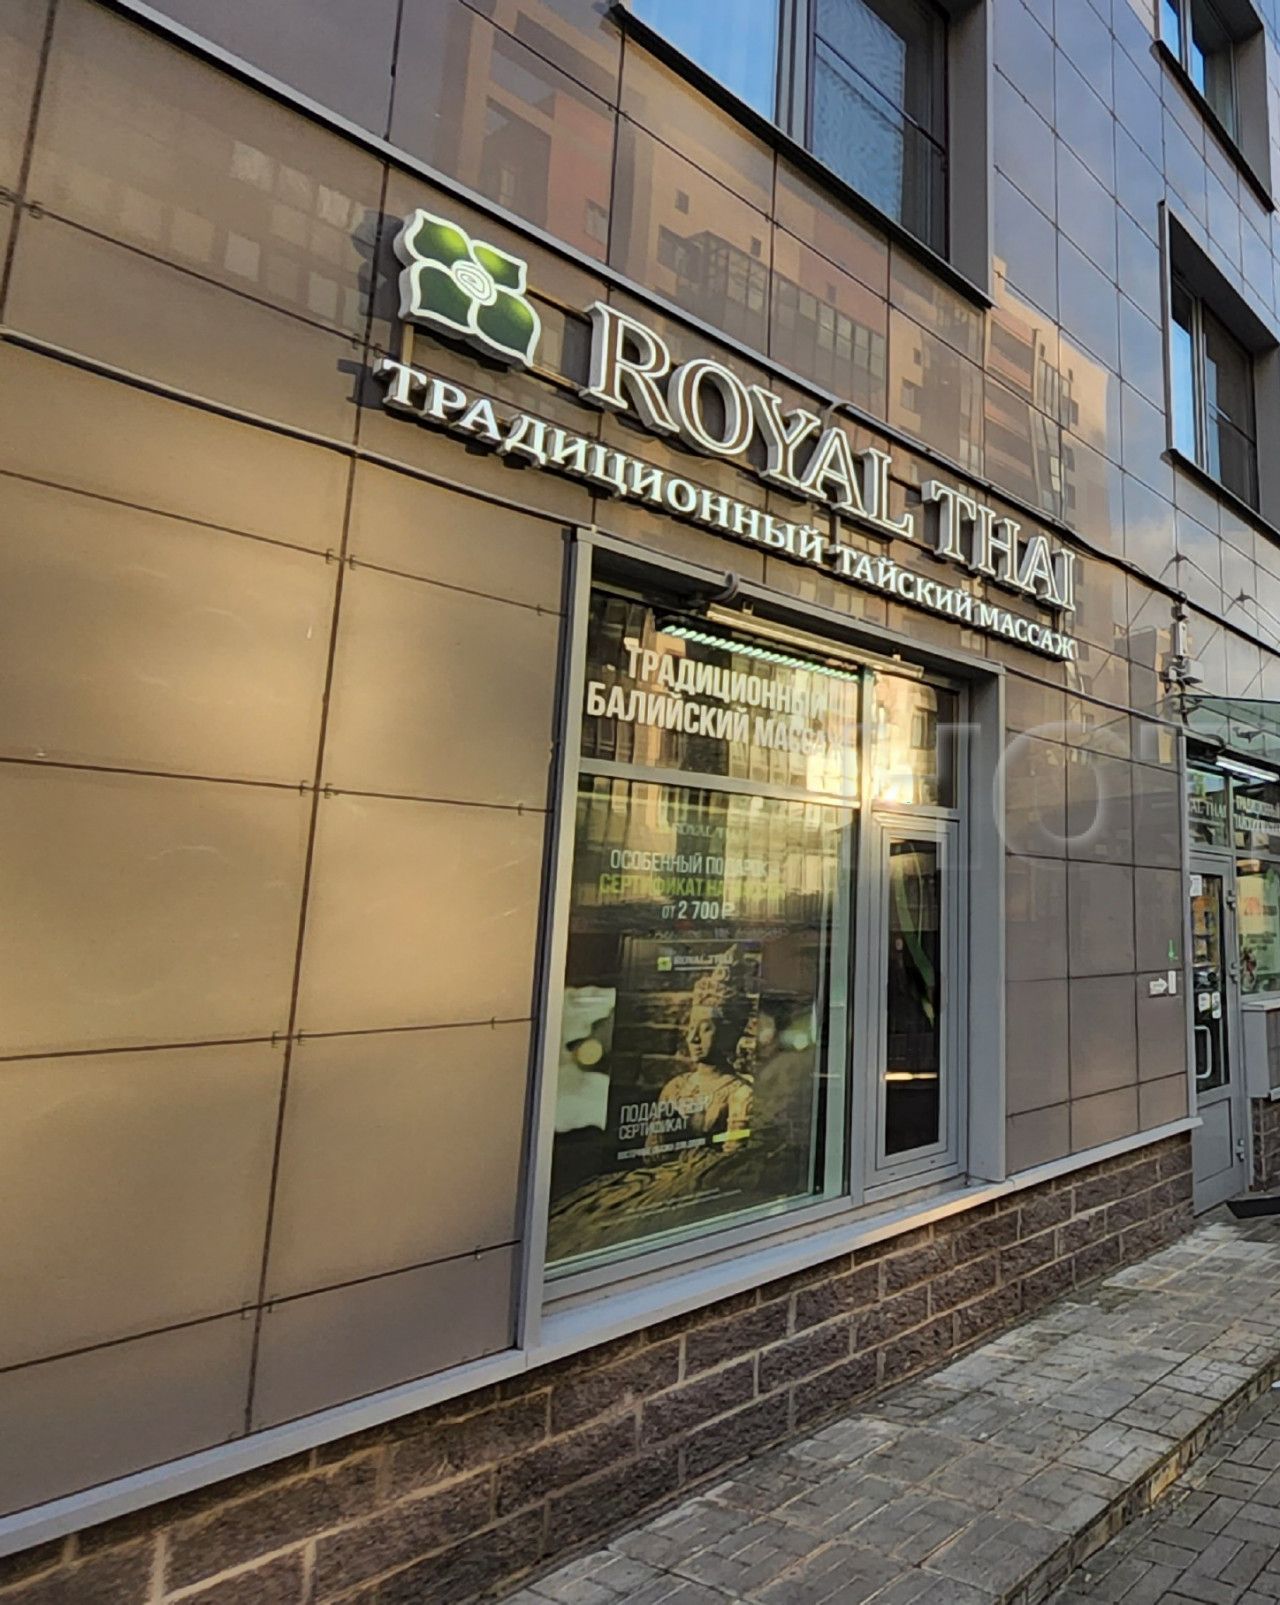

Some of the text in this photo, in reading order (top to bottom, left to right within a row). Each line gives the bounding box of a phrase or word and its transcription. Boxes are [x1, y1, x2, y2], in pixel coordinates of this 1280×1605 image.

[586, 301, 1077, 612] ROYAL THAI
[375, 358, 1077, 661] ТРАДИЦИОННЫЙ ТАЙСКИЙ МАССАЖ
[587, 680, 749, 743] БАЛИЙСКИЙ
[610, 849, 703, 874] ОСОБЕННЫЙ
[691, 901, 720, 919] 700
